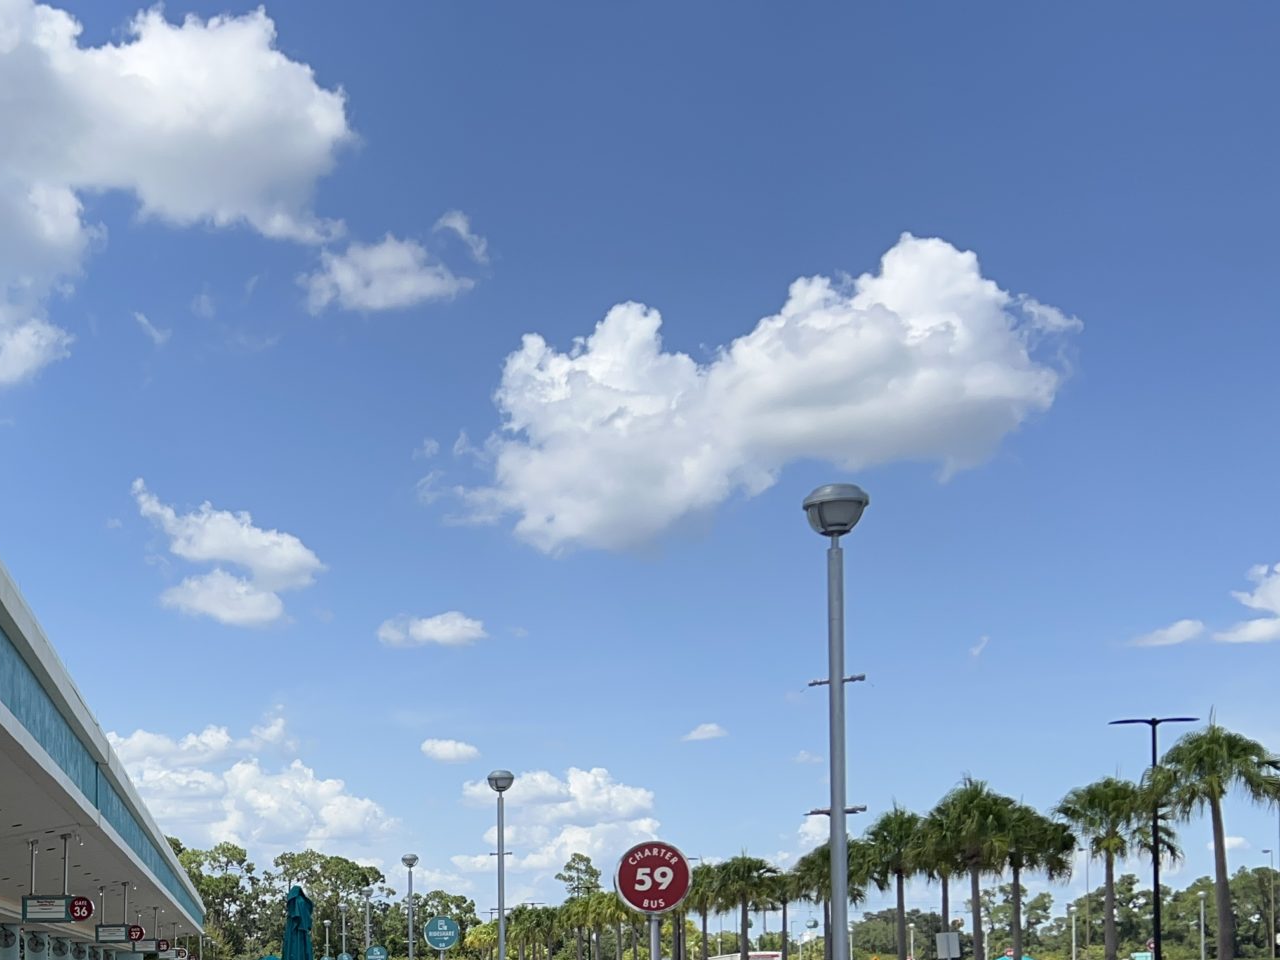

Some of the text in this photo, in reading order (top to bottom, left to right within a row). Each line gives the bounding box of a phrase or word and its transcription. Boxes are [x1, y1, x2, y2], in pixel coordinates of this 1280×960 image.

[628, 847, 679, 865] CHARTER
[634, 866, 674, 892] 59
[642, 898, 665, 909] BUS
[73, 906, 88, 917] 36
[130, 931, 140, 939] 37
